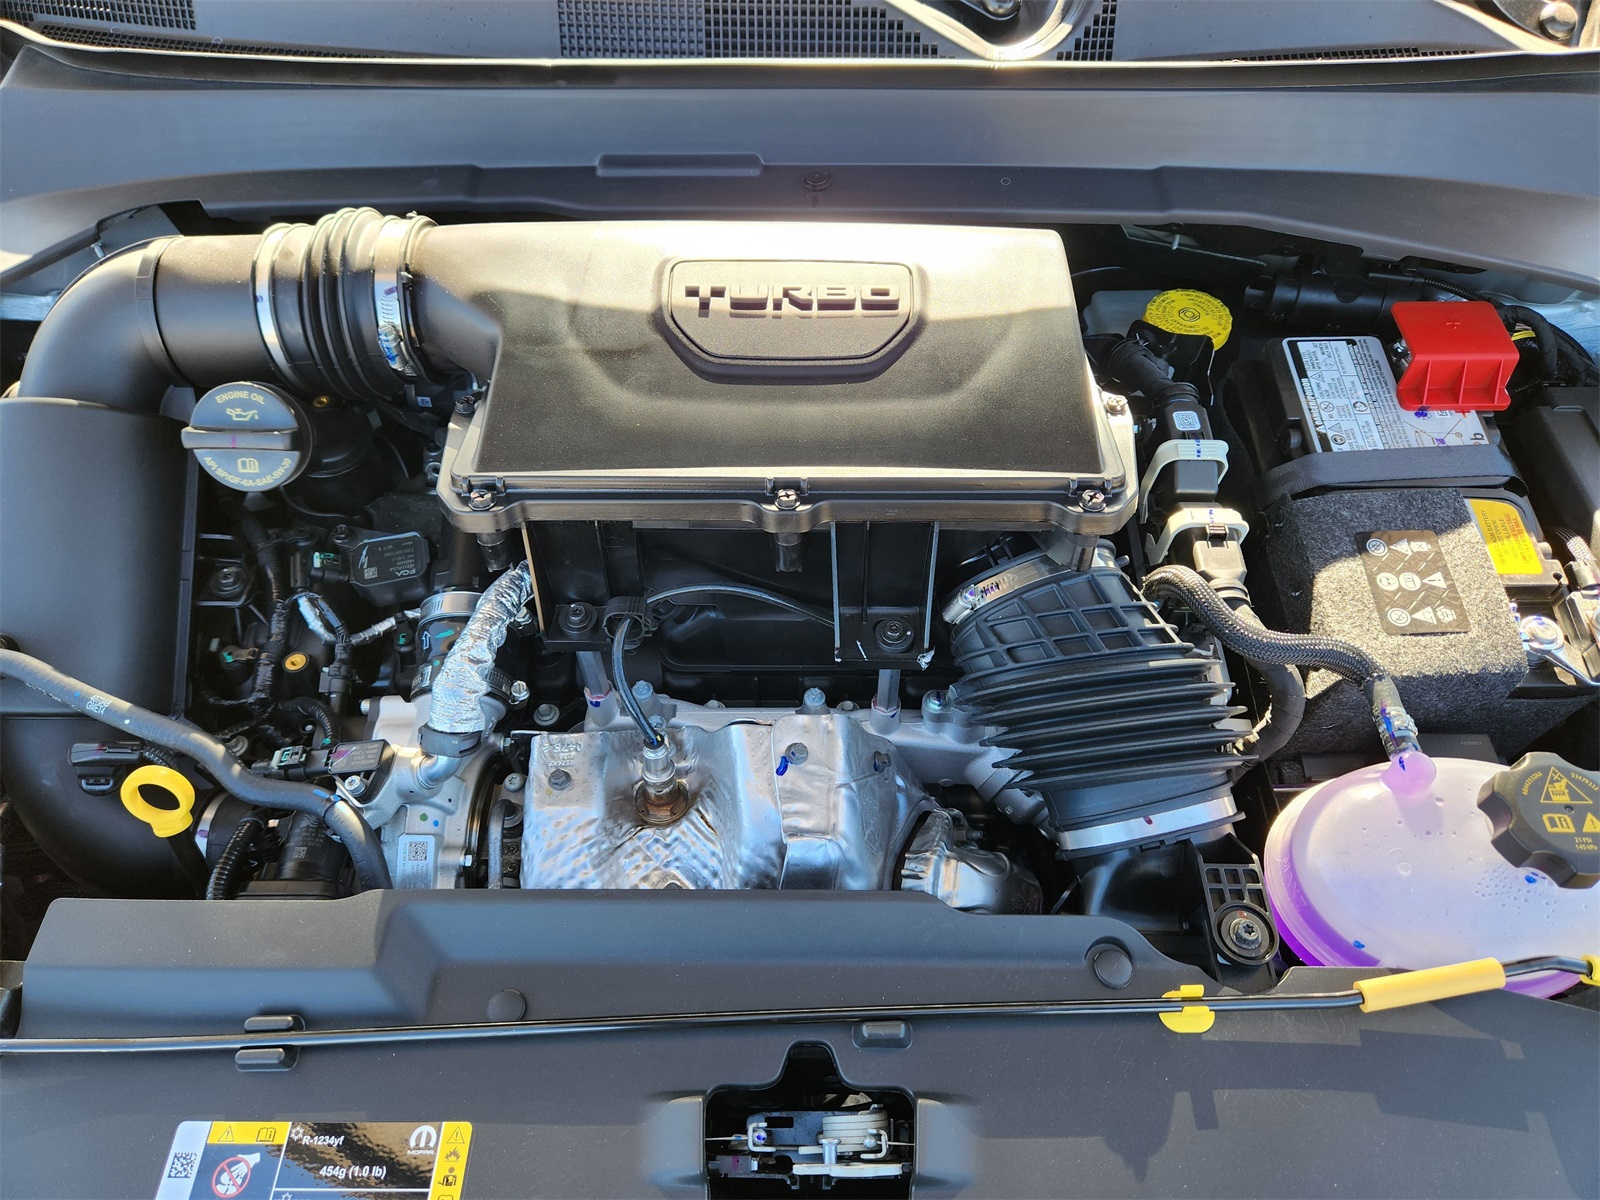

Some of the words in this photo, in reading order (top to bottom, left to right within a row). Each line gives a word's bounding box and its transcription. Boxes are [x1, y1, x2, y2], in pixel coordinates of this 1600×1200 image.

[684, 284, 900, 315] TURBO
[215, 390, 249, 404] ENGINE
[251, 393, 266, 405] OIL
[1301, 378, 1322, 424] DANGER/POISON
[204, 456, 218, 470] API
[1480, 509, 1493, 531] BATTERY
[395, 568, 416, 576] FCA
[302, 1135, 345, 1147] R-1234yf
[319, 1166, 346, 1180] 454g
[349, 1166, 369, 1180] (1.0
[371, 1165, 386, 1179] lb)
